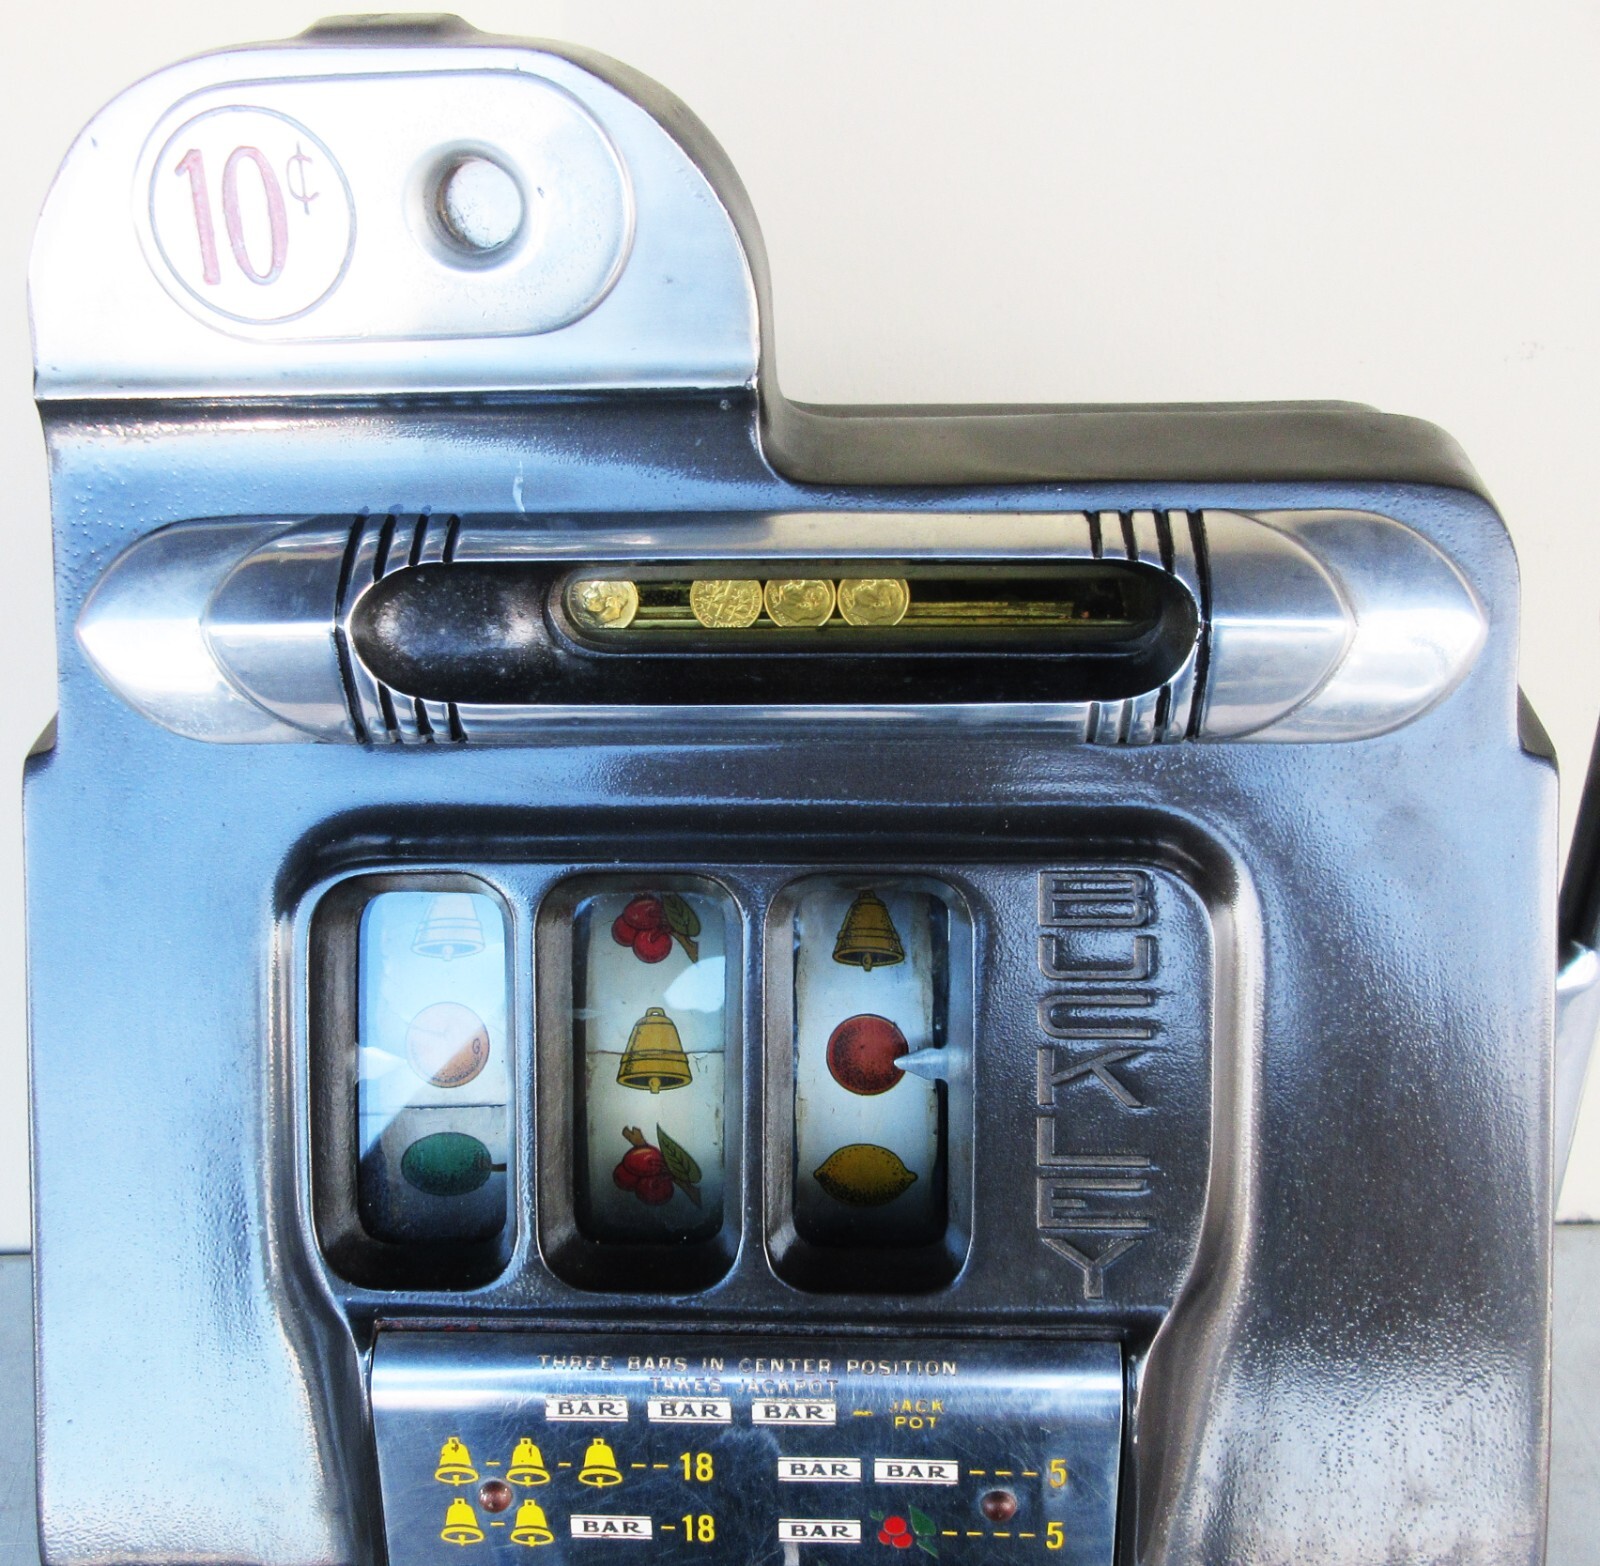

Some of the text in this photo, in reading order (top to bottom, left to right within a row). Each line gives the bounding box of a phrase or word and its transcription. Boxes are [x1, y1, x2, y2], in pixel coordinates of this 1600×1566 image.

[174, 141, 320, 286] 10¢
[1037, 869, 1151, 1299] BUCKLEY
[537, 1355, 957, 1377] THREE BARS IN CENTER POSITION
[650, 1377, 839, 1394] TAKES JACKPOT
[557, 1402, 828, 1420] BAR BAR BAR
[889, 1399, 945, 1414] JACK
[894, 1417, 939, 1430] POT
[680, 1452, 714, 1482] 18
[790, 1459, 1068, 1488] BAR BAR 5
[582, 1514, 715, 1543] BAR 18
[790, 1522, 1064, 1550] BAR 5
